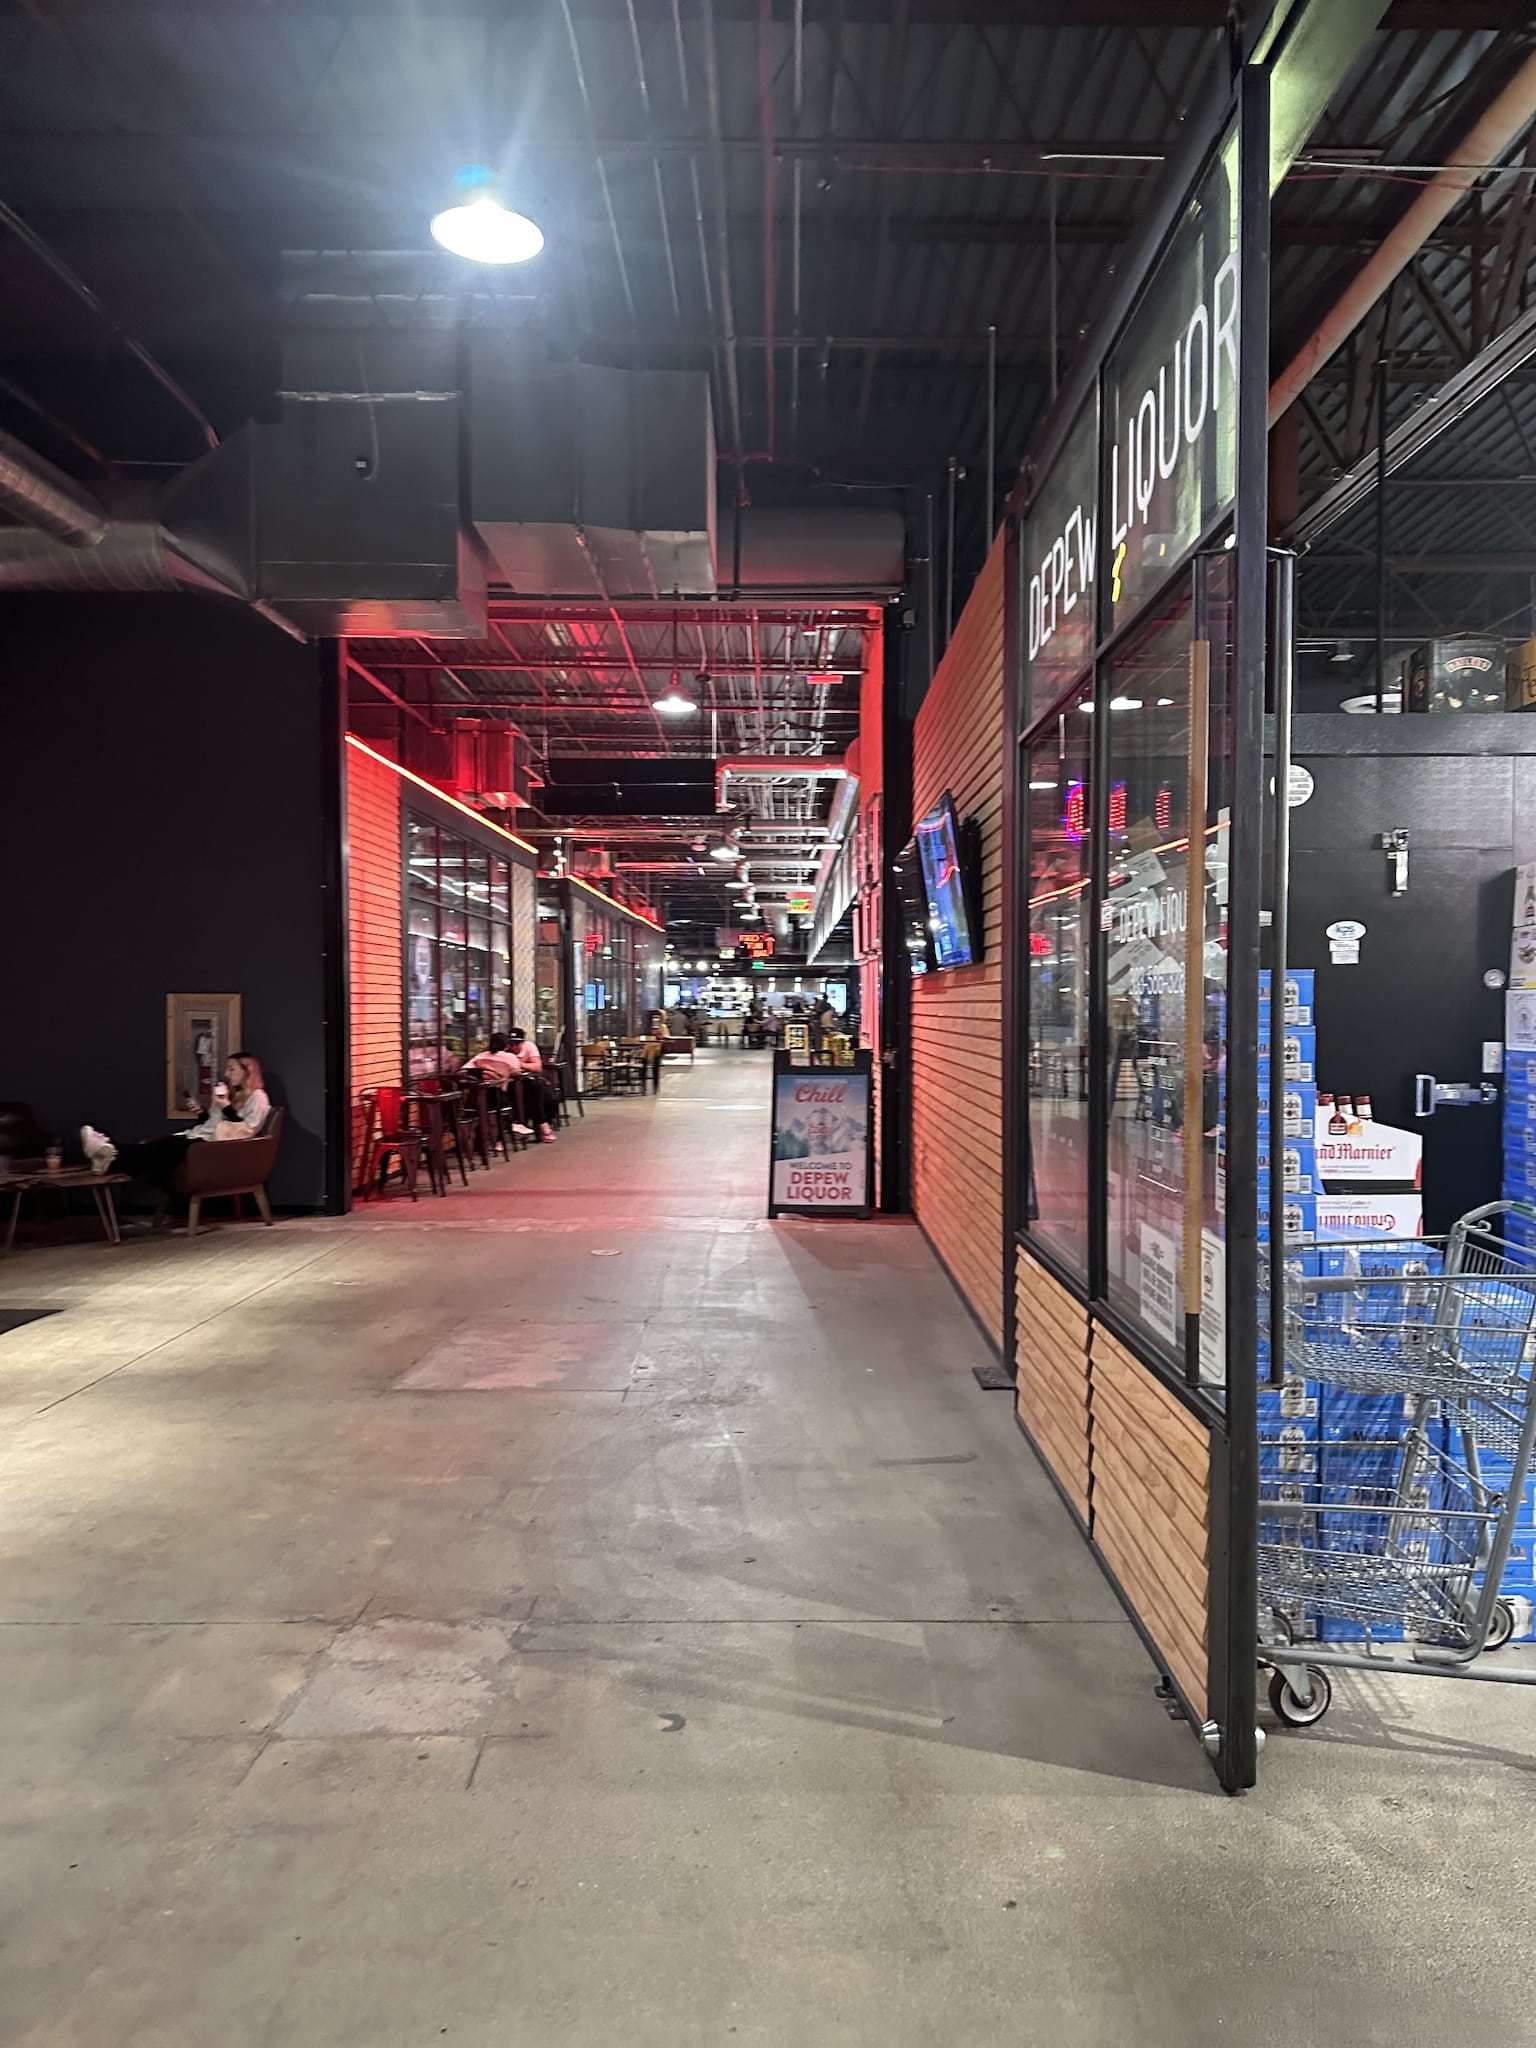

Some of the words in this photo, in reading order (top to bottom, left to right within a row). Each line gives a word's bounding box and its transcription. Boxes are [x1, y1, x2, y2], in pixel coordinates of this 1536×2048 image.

[1028, 504, 1096, 661] DEPEW
[1111, 253, 1239, 550] LIQUOR
[795, 1084, 848, 1103] Chill
[1335, 1143, 1394, 1160] Marnier
[791, 1172, 849, 1185] DEPEW
[786, 1186, 852, 1202] LIQUOR
